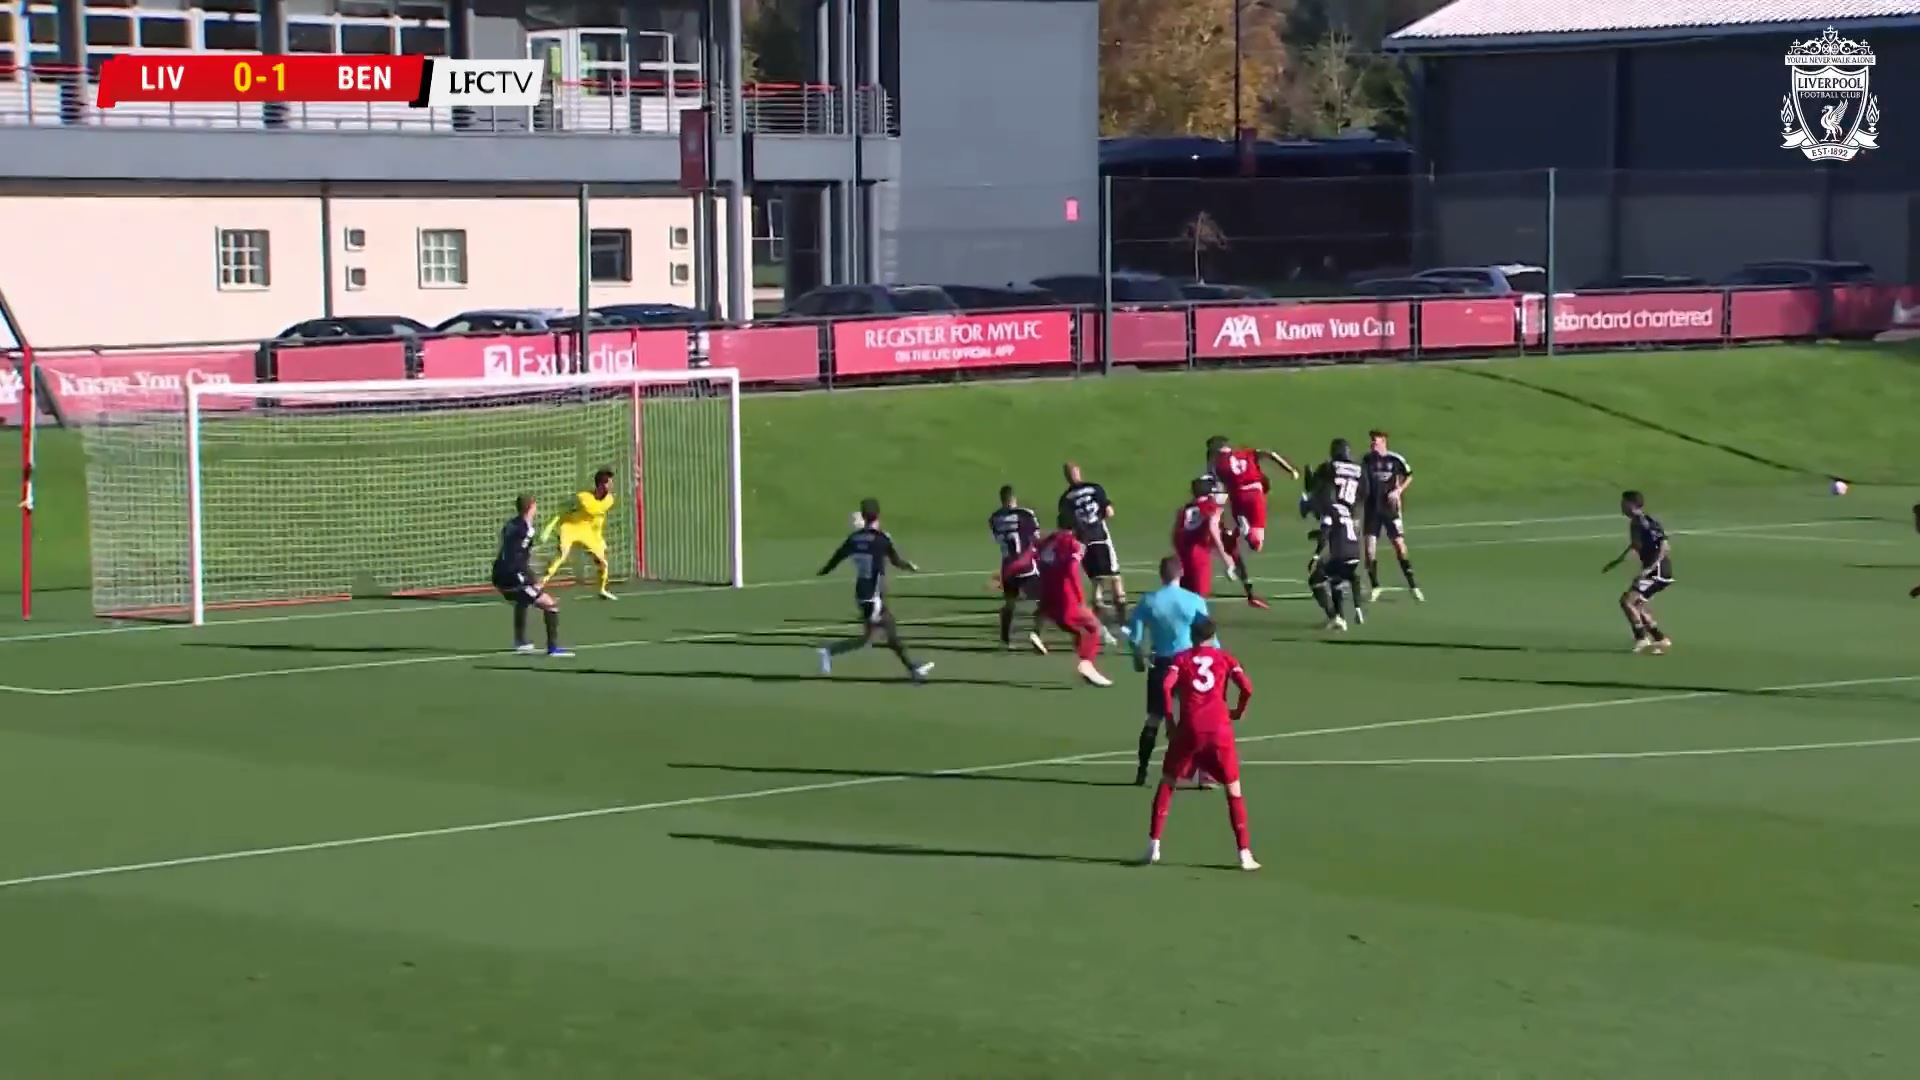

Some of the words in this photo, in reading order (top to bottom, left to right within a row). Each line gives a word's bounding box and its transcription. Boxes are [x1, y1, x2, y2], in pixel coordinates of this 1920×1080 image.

[1212, 315, 1262, 348] AXA
[1275, 319, 1325, 341] Know
[1328, 318, 1361, 338] You
[1363, 316, 1396, 337] Can
[1553, 310, 1632, 332] standard
[1633, 307, 1713, 329] chartered
[864, 326, 947, 348] REGISTER
[950, 323, 984, 344] FOR
[987, 320, 1043, 341] MYLFC
[59, 372, 131, 397] Know
[133, 370, 180, 390] You
[1192, 655, 1215, 693] 3
